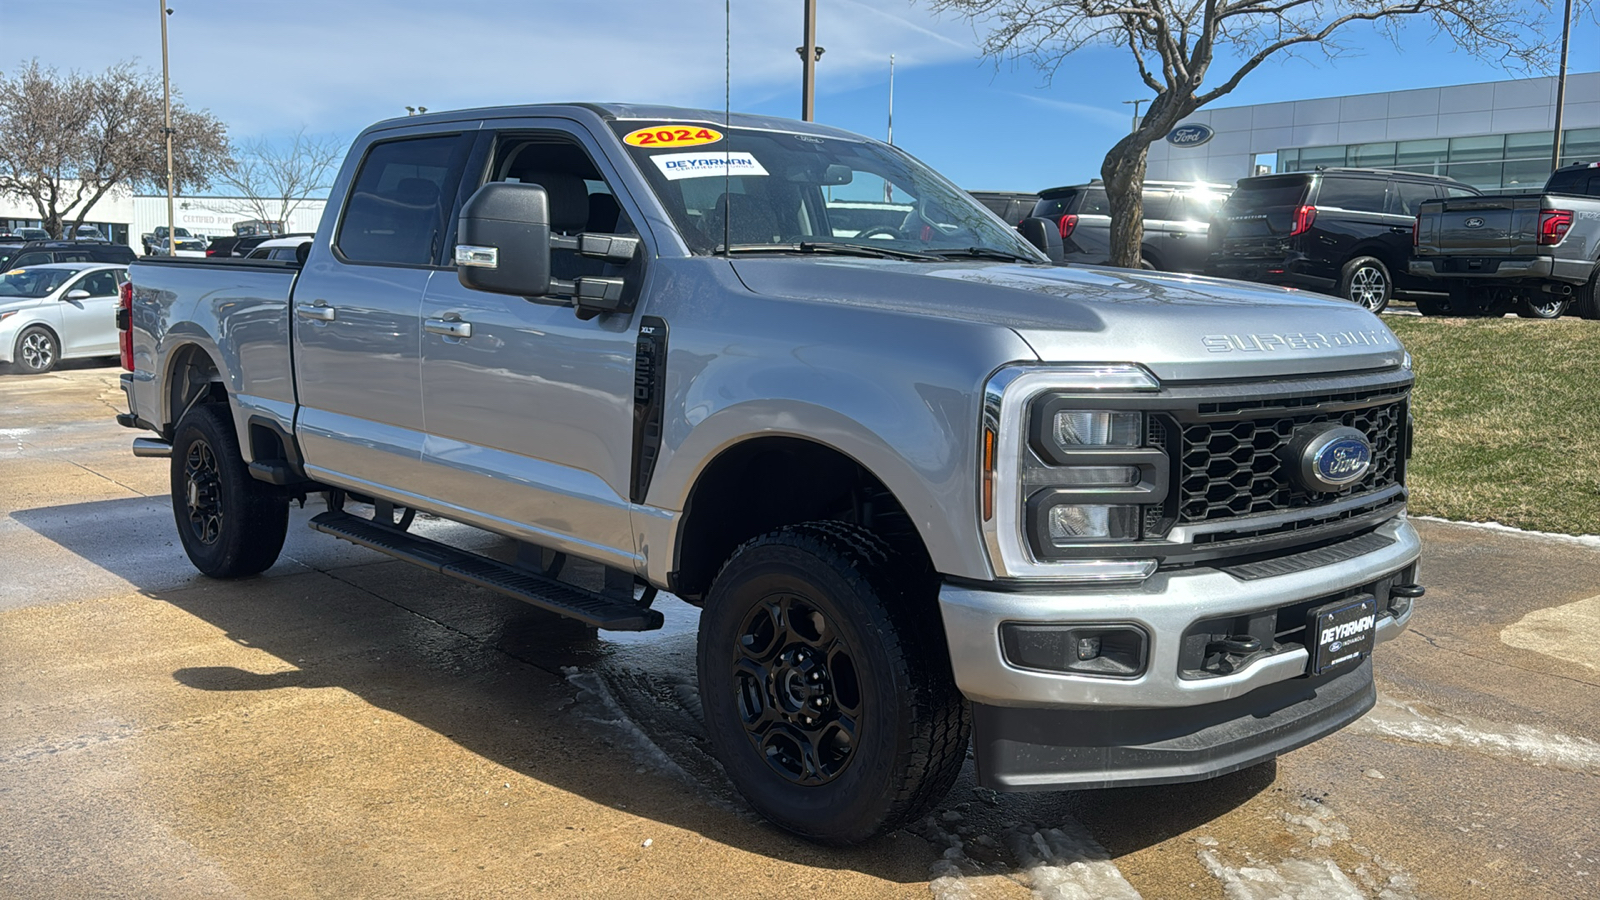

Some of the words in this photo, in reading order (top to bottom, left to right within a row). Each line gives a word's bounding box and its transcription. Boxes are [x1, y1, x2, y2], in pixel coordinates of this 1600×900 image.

[636, 129, 714, 145] 2024
[1173, 128, 1202, 143] Ford
[665, 158, 752, 169] DEYARMAN
[182, 214, 215, 224] CERTIFIED
[640, 326, 655, 334] XLT
[1201, 332, 1332, 353] SUPER
[1328, 329, 1390, 348] DUTY
[1329, 446, 1362, 474] Ford
[1320, 613, 1375, 646] DEYARMAN
